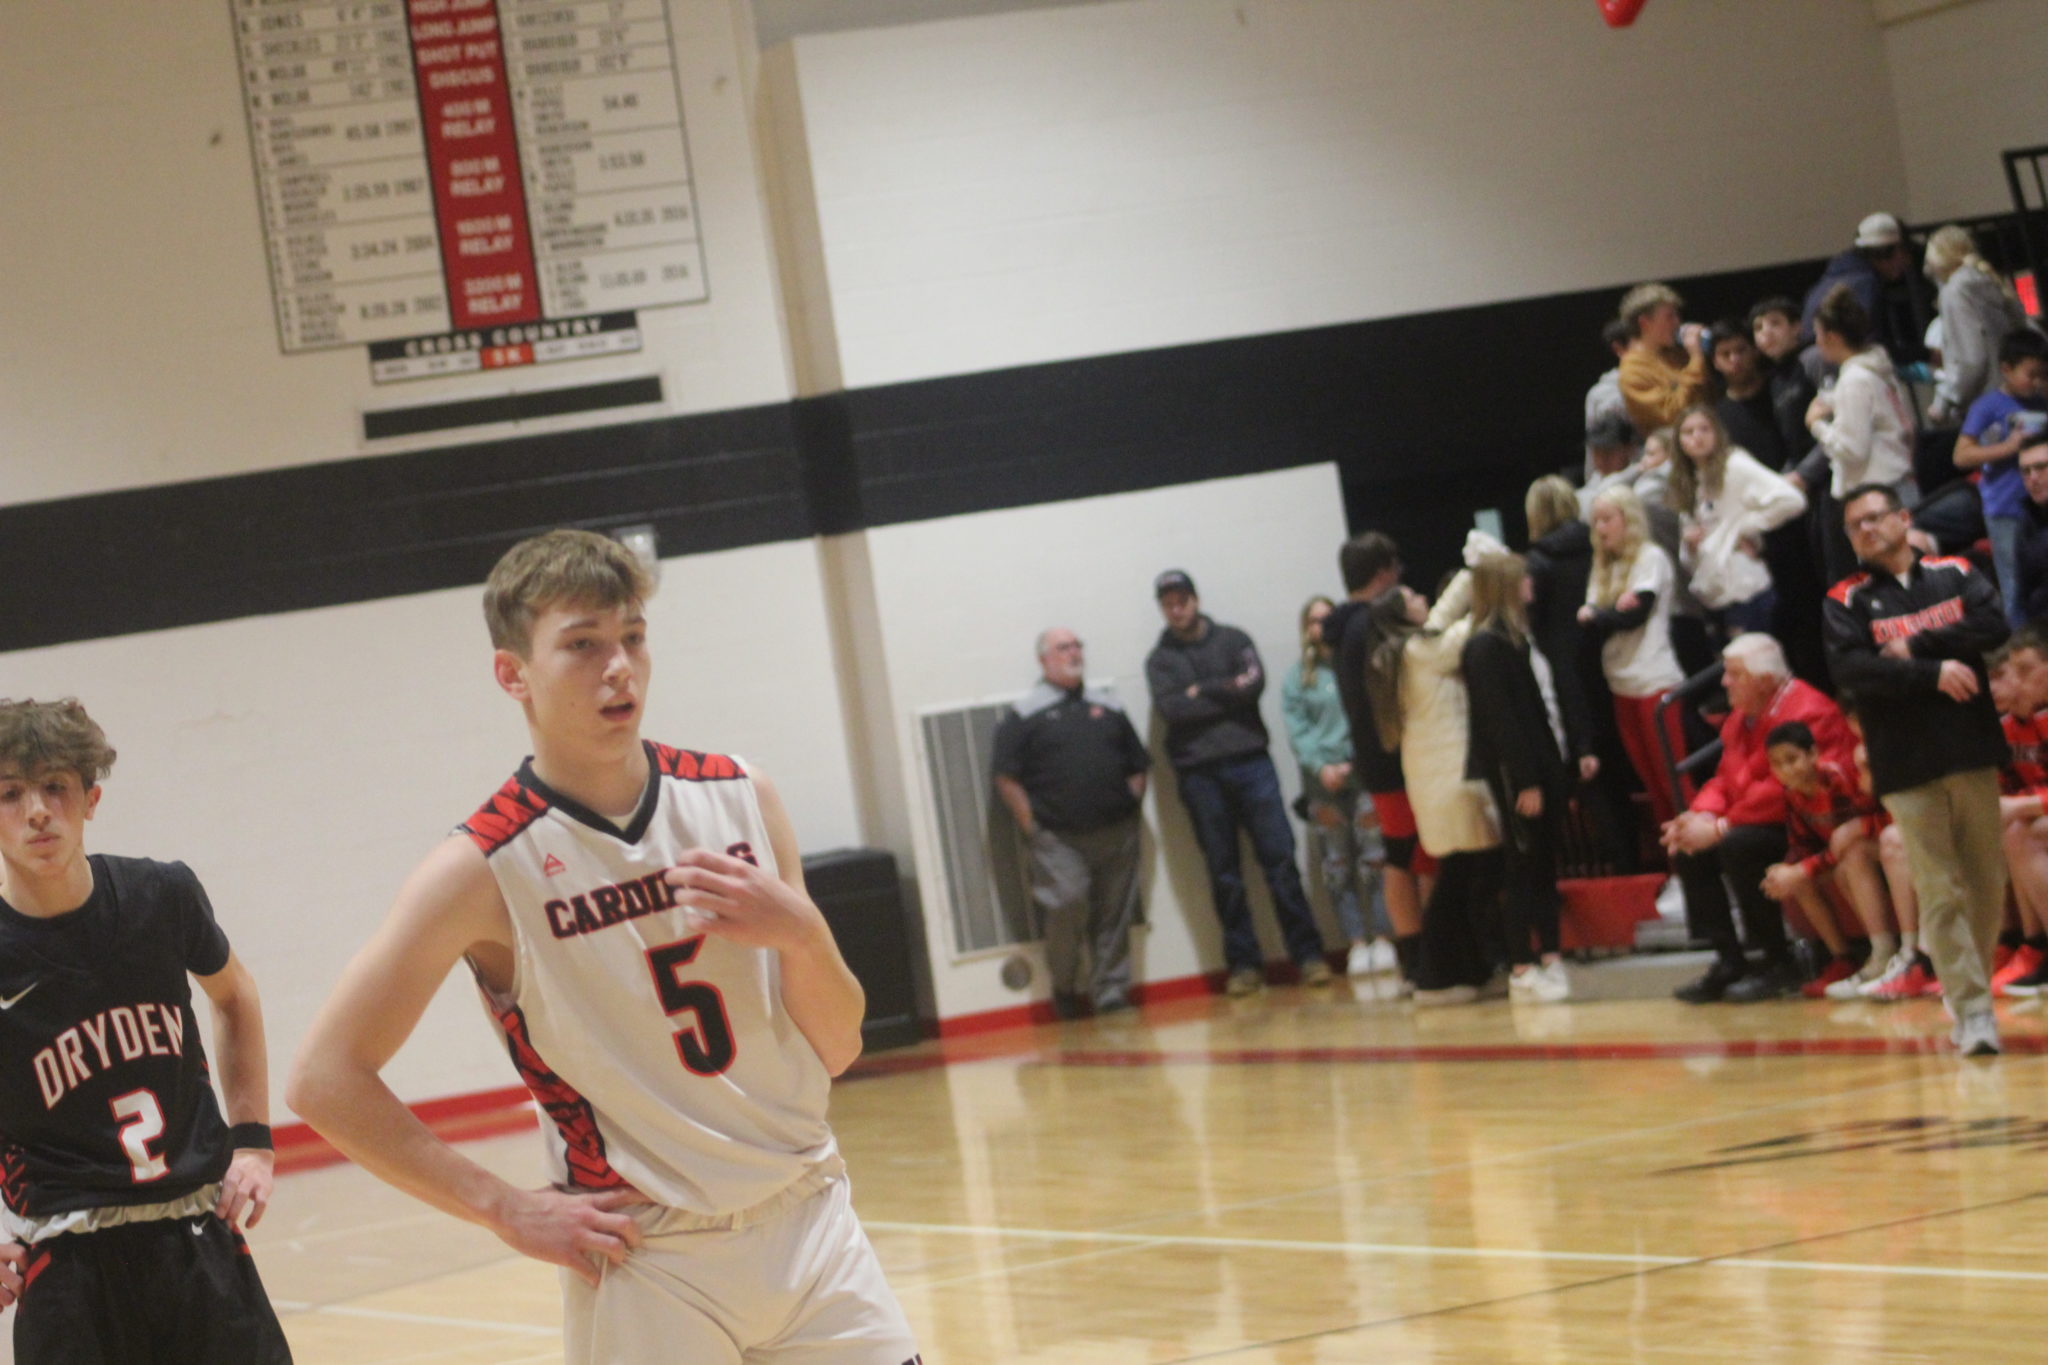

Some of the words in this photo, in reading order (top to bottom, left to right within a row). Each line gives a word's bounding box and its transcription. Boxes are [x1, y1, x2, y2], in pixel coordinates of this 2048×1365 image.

[464, 40, 498, 60] PUT
[429, 67, 495, 89] DISCUS
[441, 118, 495, 139] RELAY
[450, 175, 505, 197] RELAY
[458, 234, 514, 257] RELAY
[467, 294, 522, 316] RELAY
[404, 332, 483, 355] CROSS
[492, 317, 602, 347] COUNTRY
[643, 933, 738, 1078] 5
[32, 1001, 184, 1110] DRYDEN
[108, 1087, 171, 1183] 2
